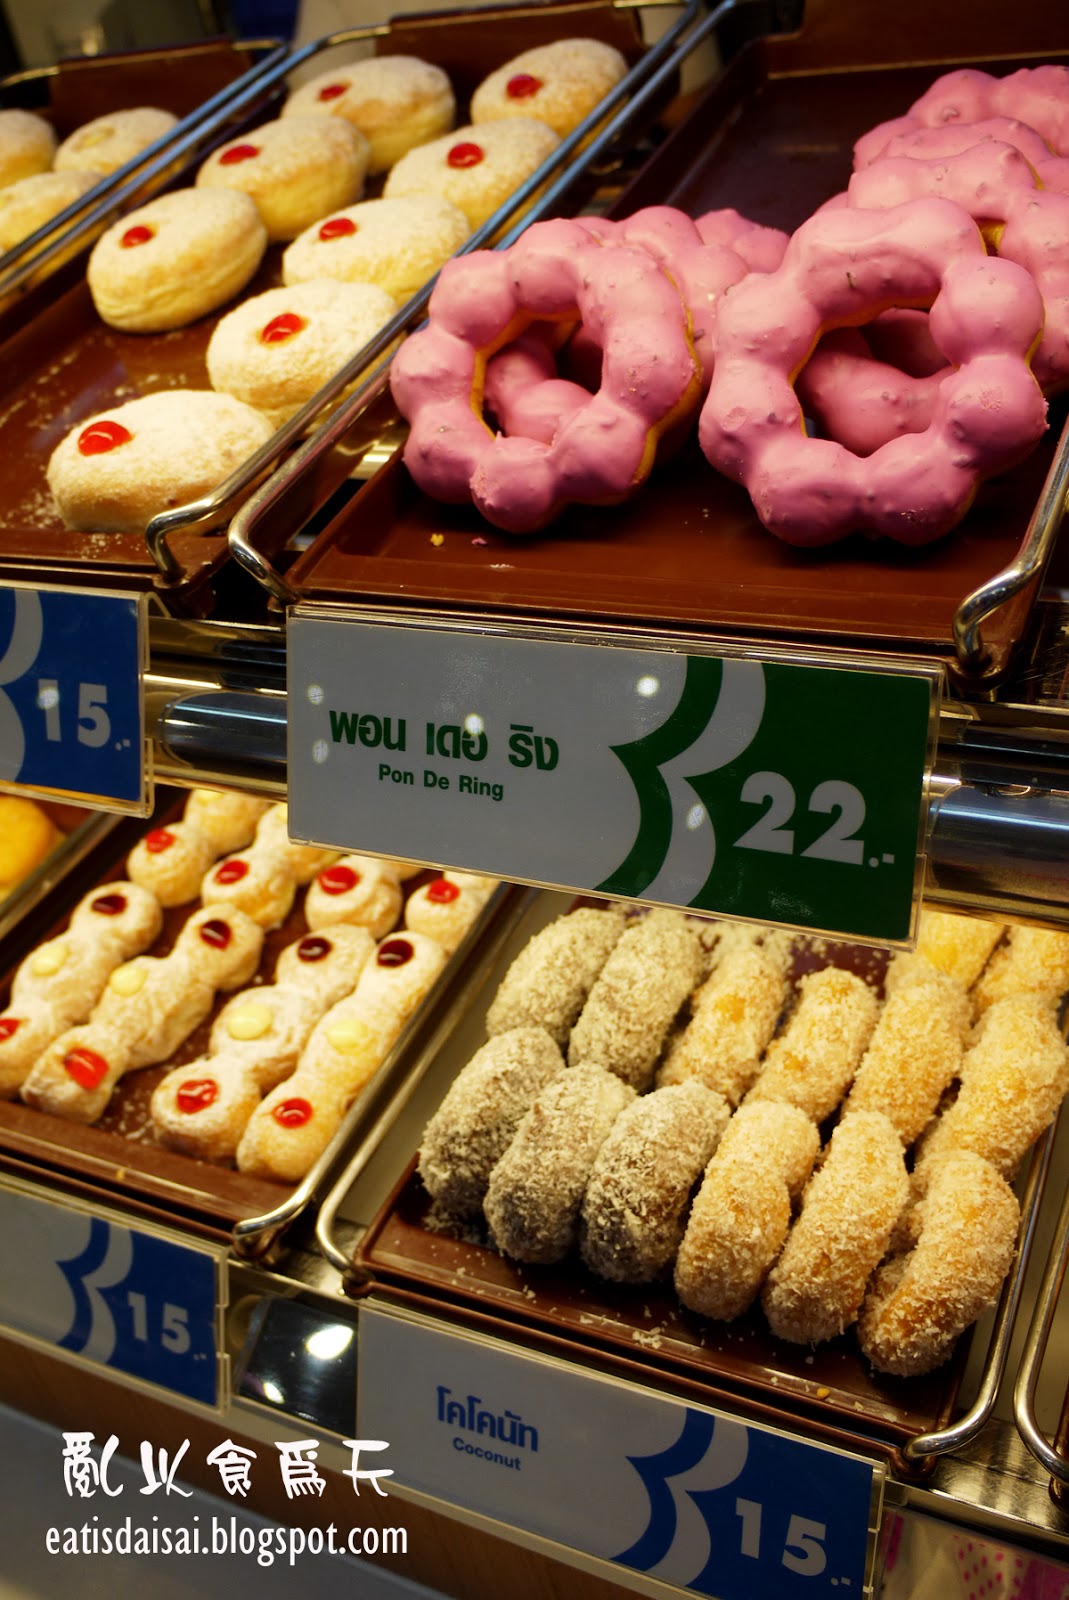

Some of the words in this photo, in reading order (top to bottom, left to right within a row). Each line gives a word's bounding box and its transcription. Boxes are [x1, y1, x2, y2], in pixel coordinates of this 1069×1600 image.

[329, 710, 407, 752] พอน
[378, 764, 415, 785] Pon
[423, 770, 450, 789] De
[459, 775, 504, 801] Ring
[436, 1385, 539, 1452] โคโคนัท
[453, 1437, 522, 1471] Coconut
